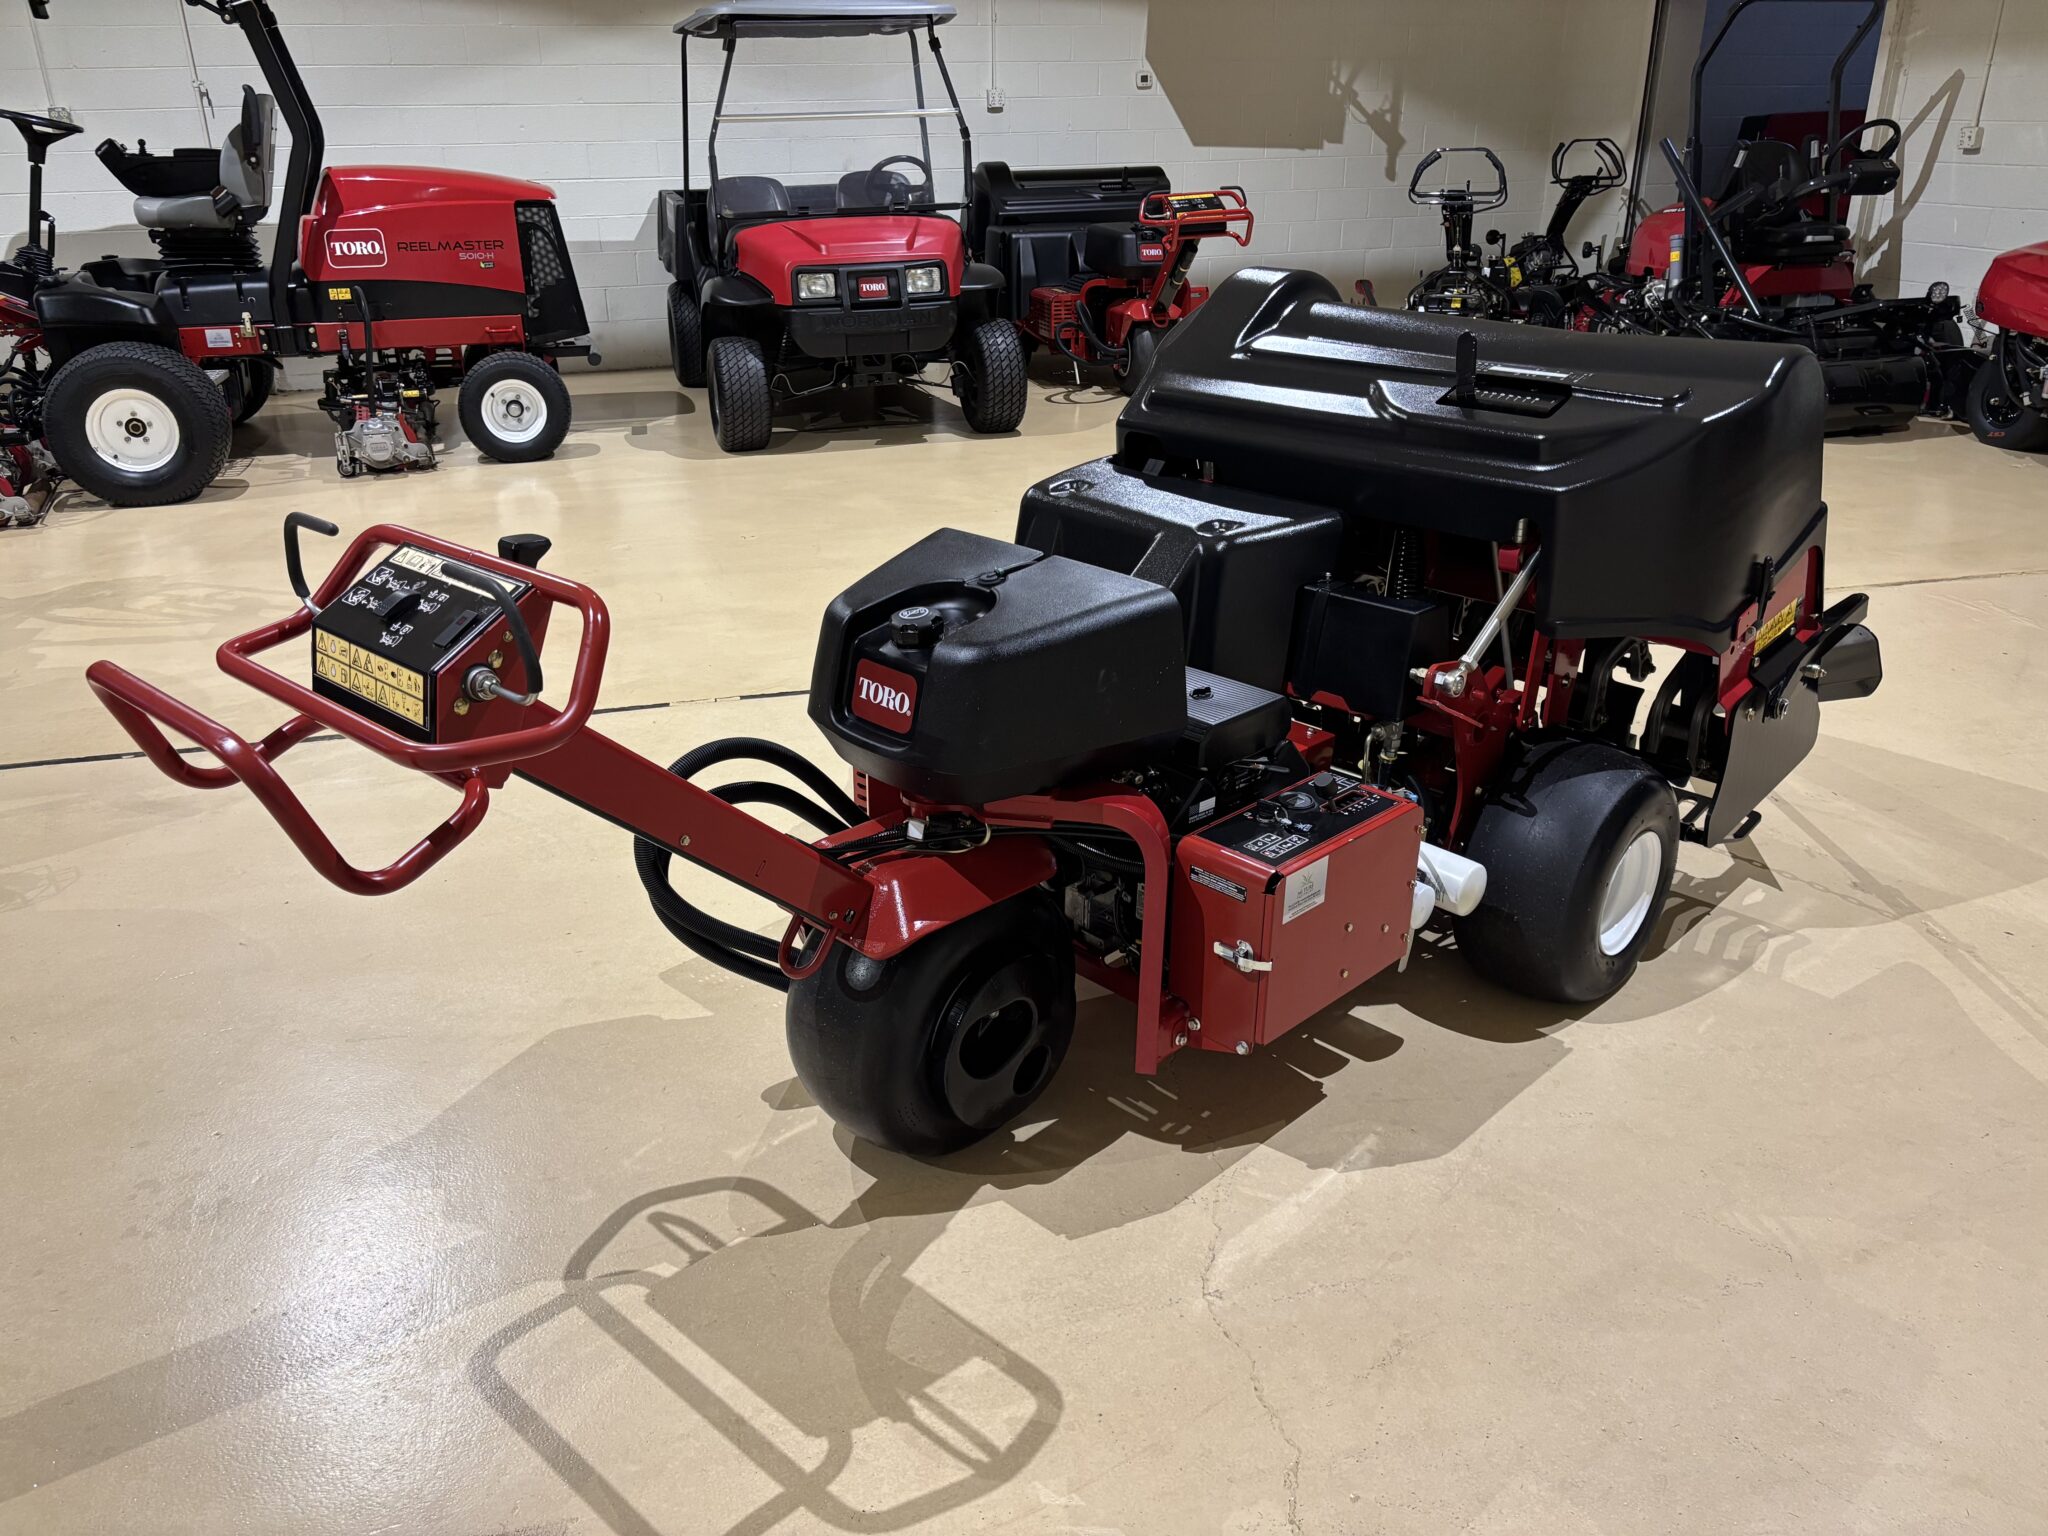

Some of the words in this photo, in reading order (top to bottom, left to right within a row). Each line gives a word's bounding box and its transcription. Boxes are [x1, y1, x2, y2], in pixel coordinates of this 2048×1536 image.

[330, 240, 382, 256] TORO
[397, 239, 504, 252] REELMASTER
[1142, 249, 1162, 257] TORO
[861, 283, 886, 292] TORO
[859, 676, 911, 717] TORO
